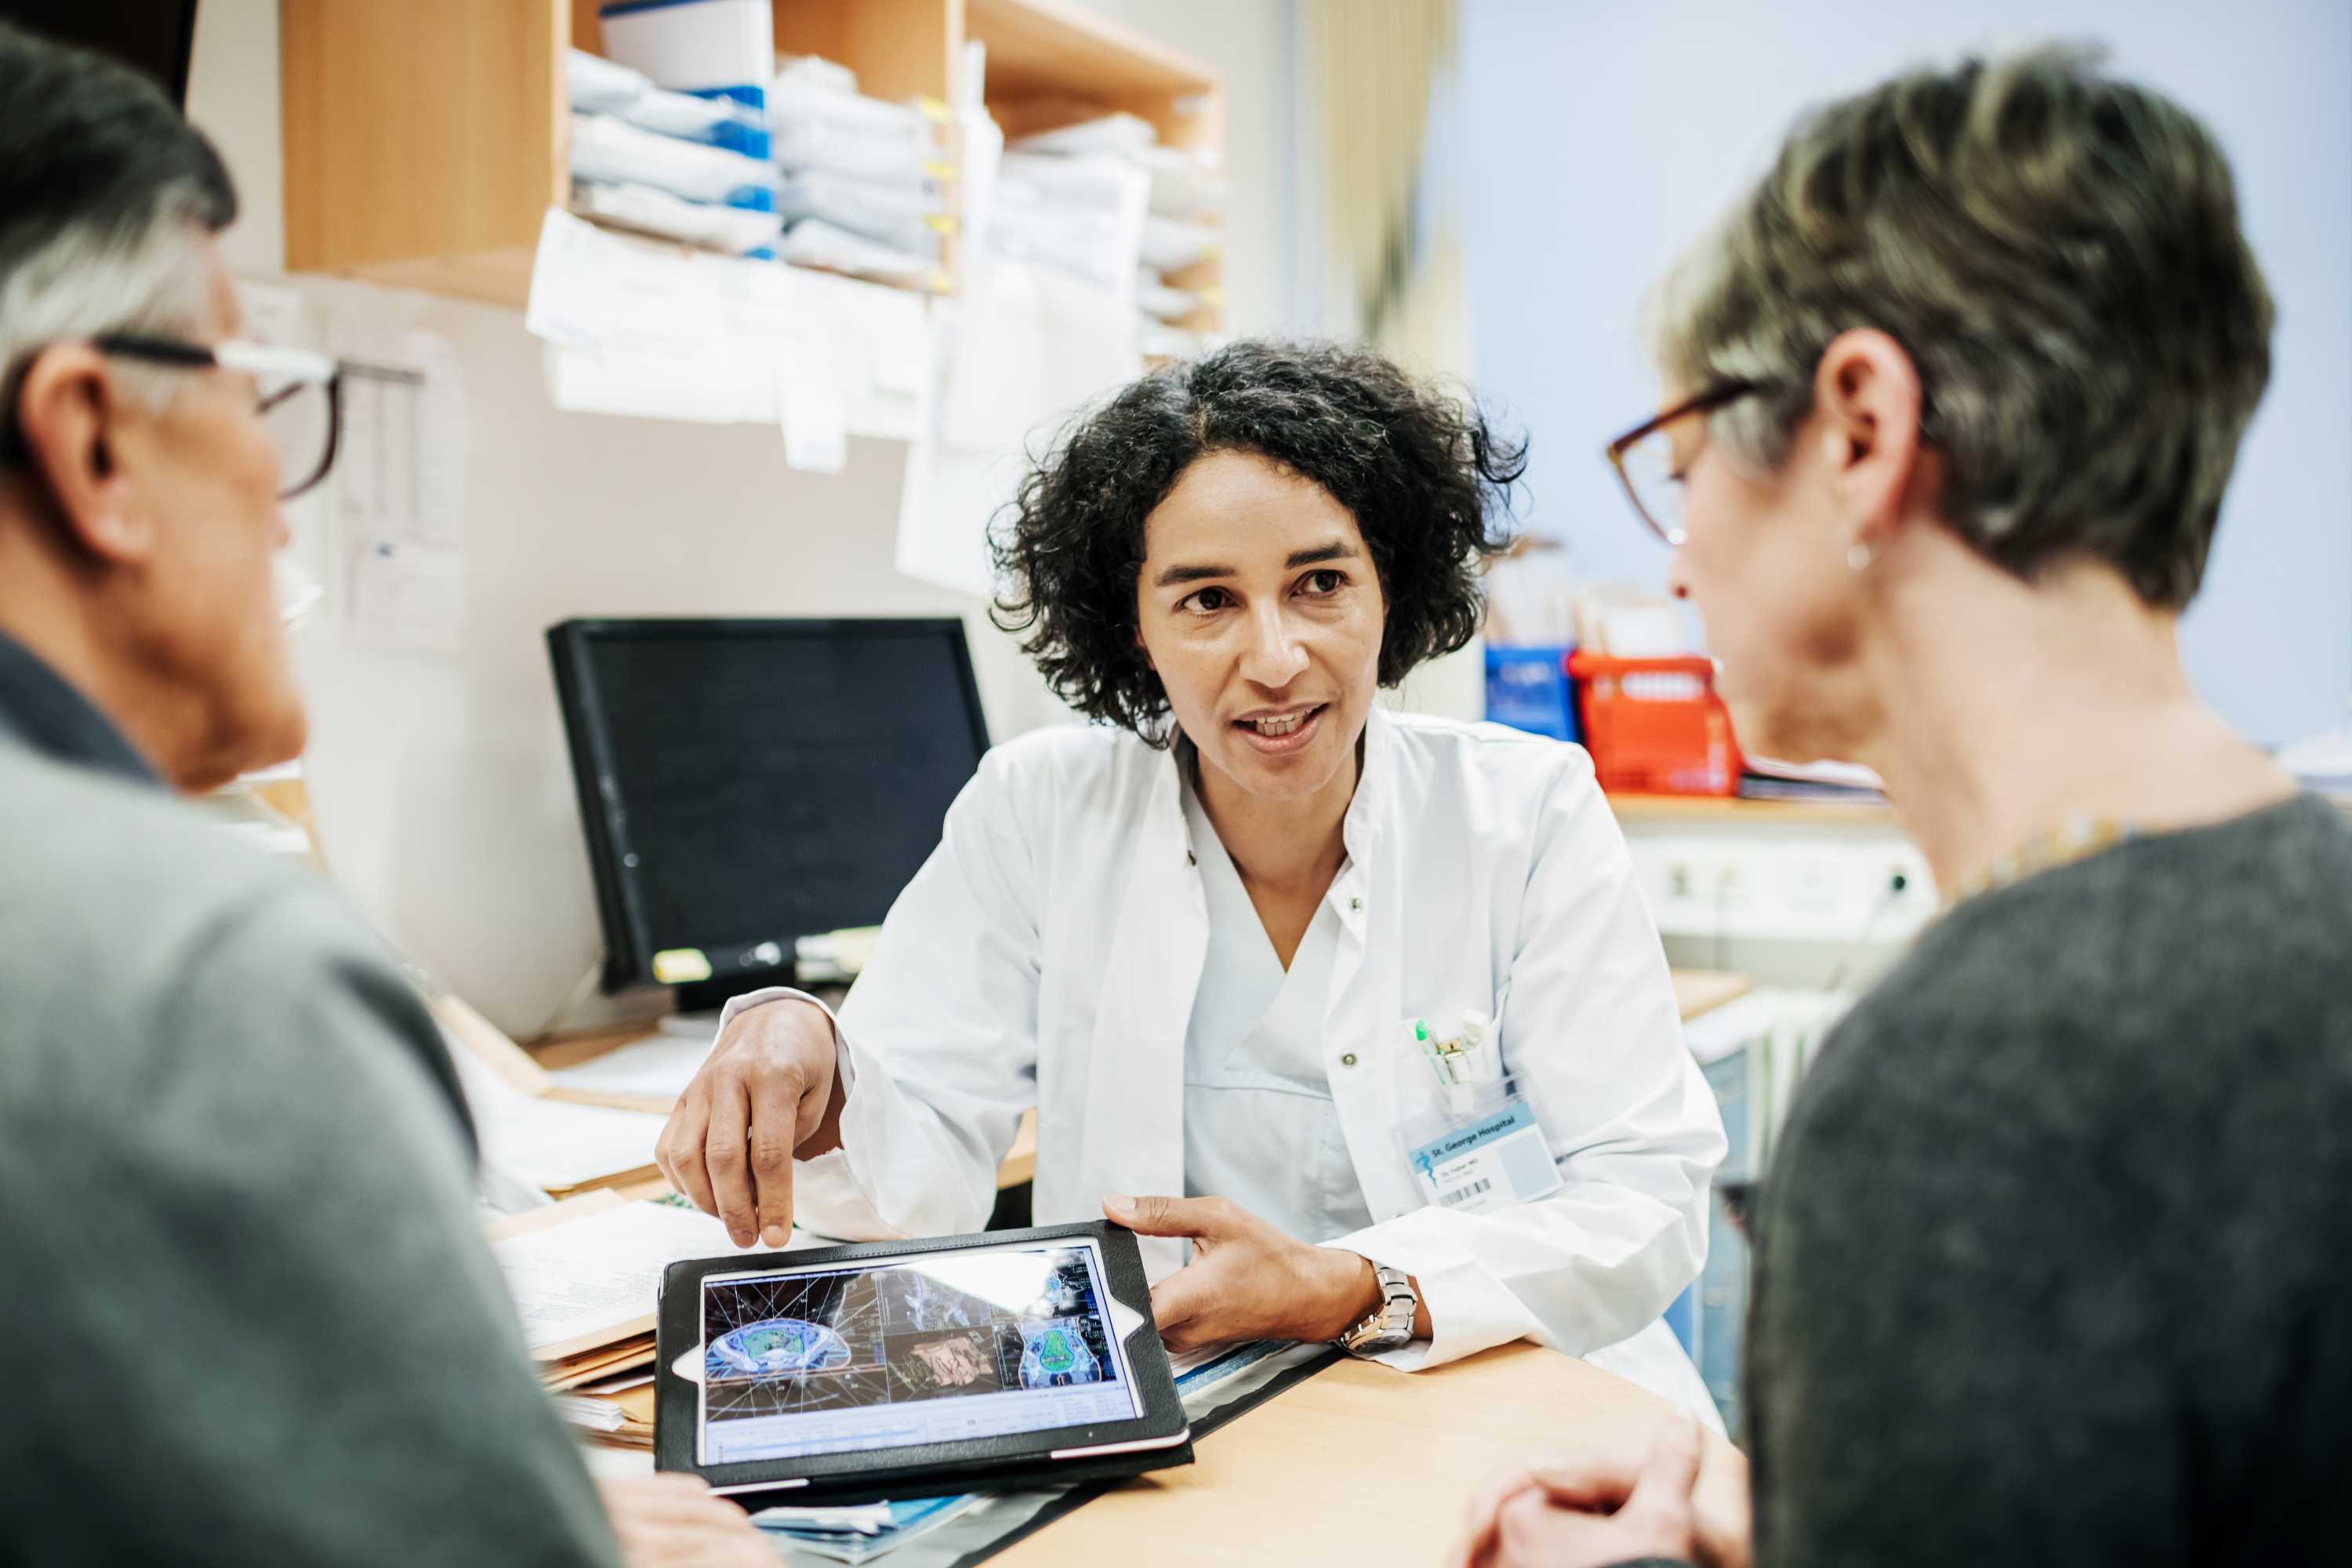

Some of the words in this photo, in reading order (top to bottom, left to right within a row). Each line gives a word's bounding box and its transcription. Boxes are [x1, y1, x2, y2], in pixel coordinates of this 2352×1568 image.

[1431, 1149, 1444, 1158] St.
[1445, 1134, 1477, 1152] George
[1478, 1115, 1515, 1138] Hospital
